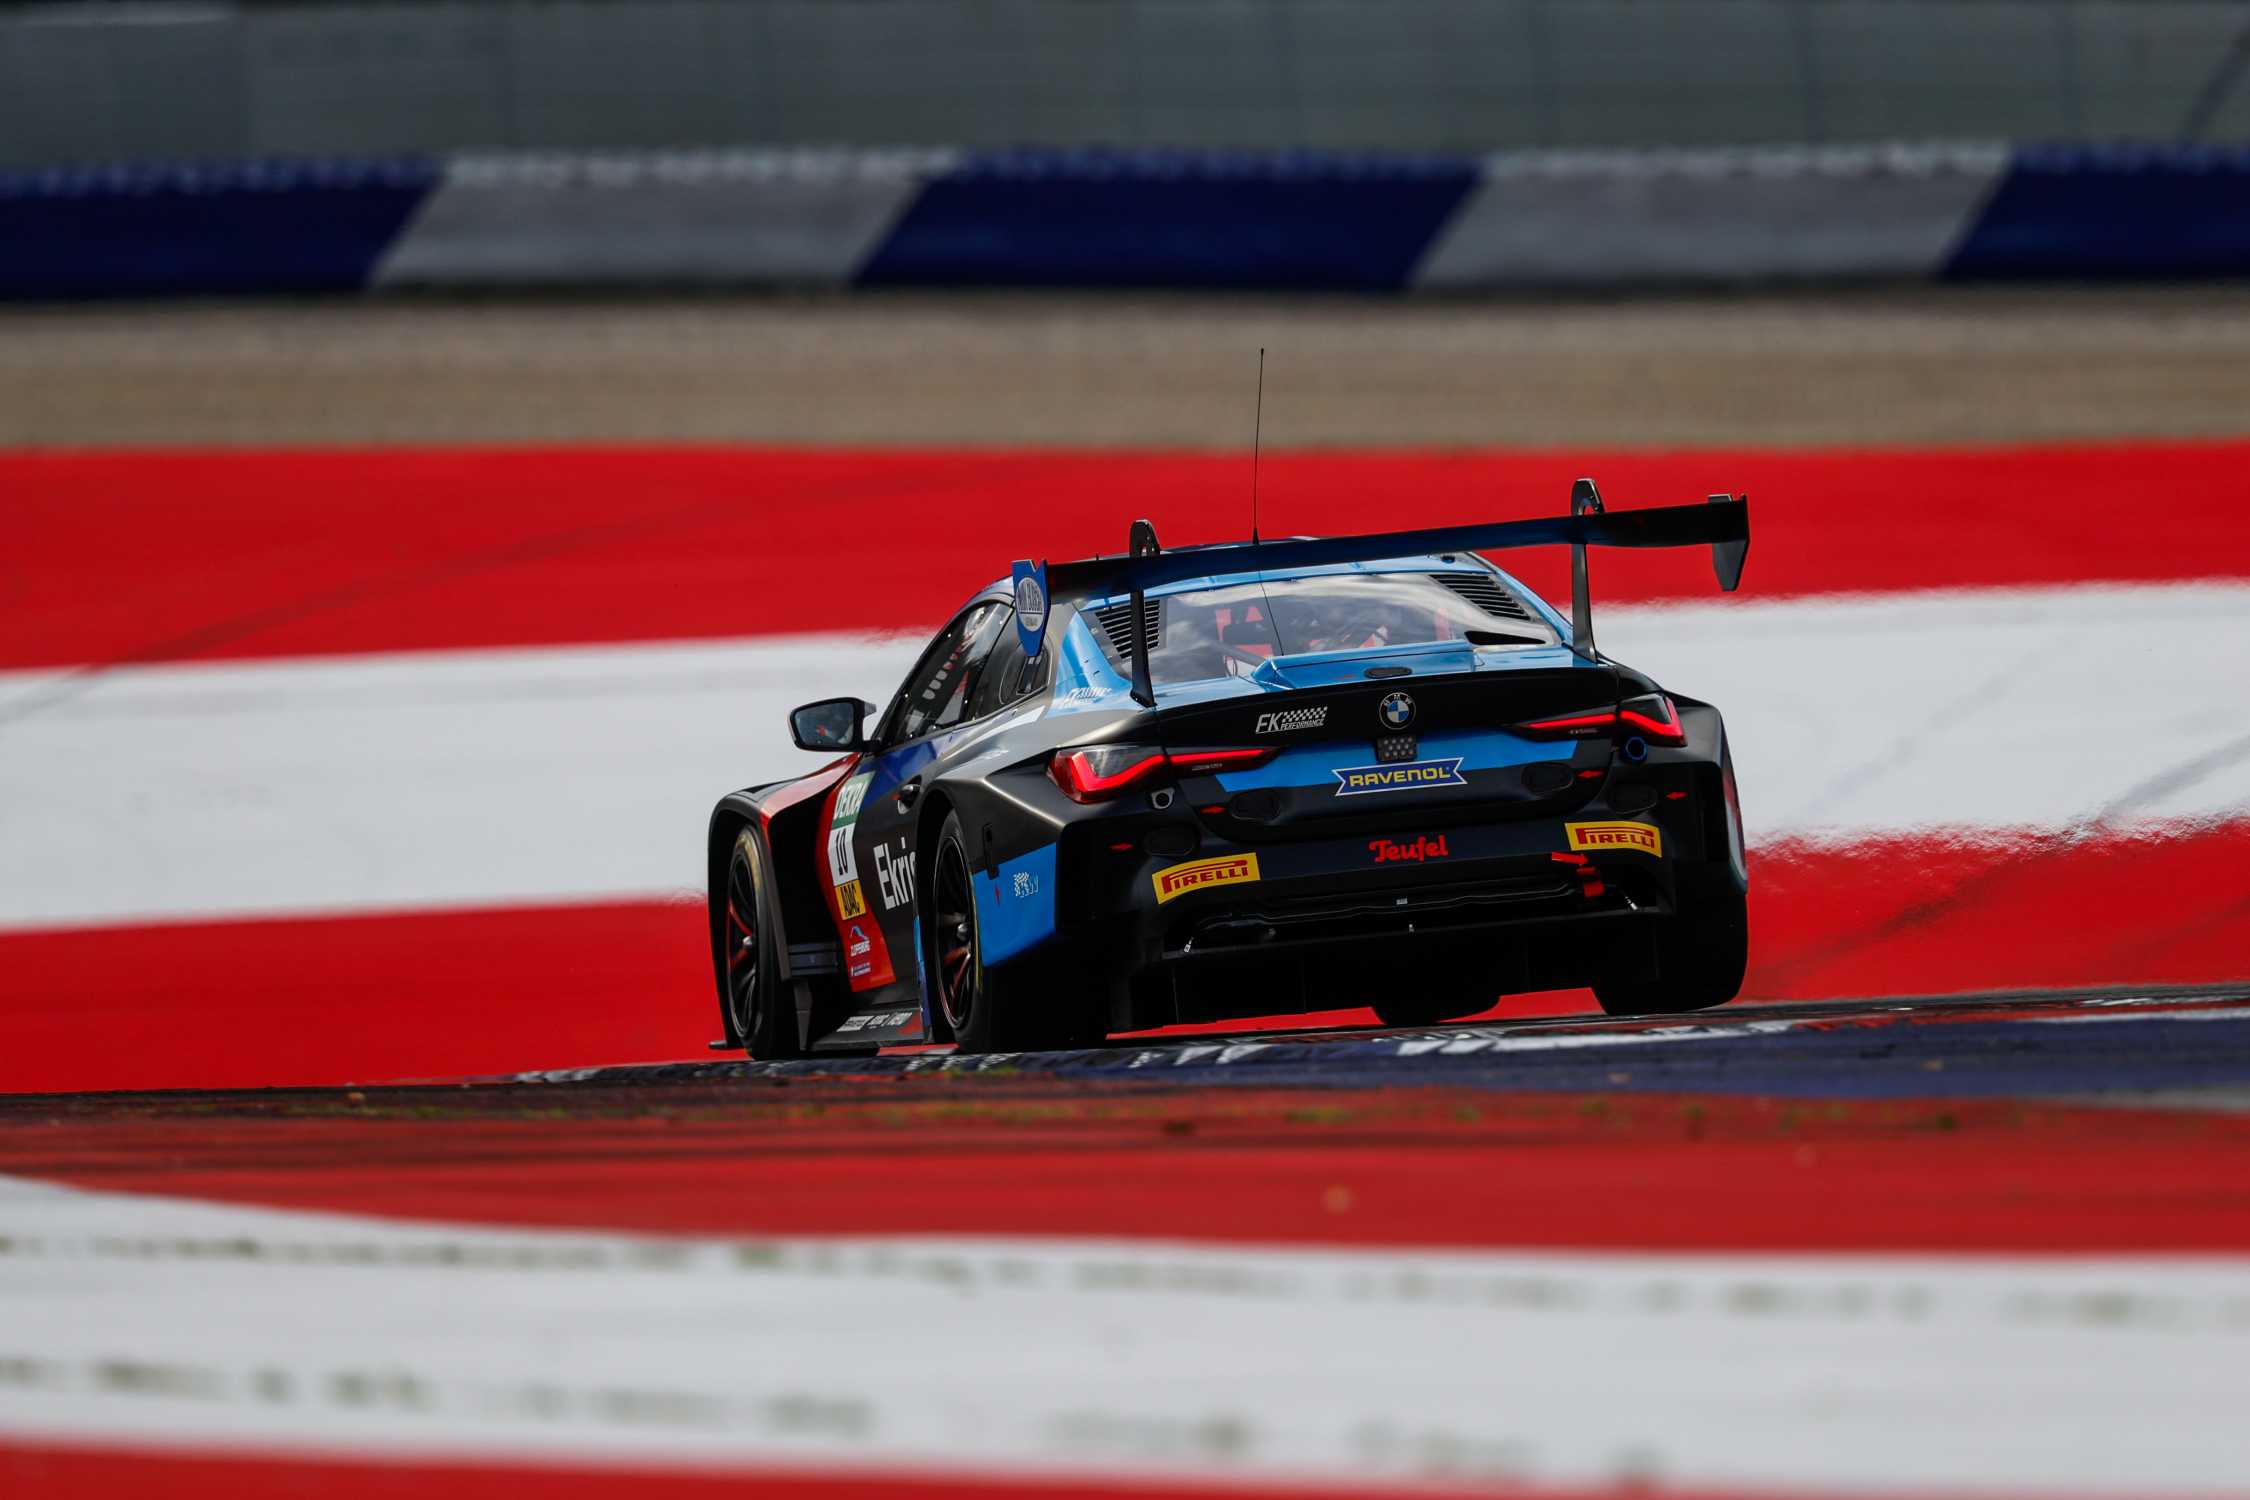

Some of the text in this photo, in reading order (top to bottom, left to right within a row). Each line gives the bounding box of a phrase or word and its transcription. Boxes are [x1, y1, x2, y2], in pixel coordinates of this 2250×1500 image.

[1256, 711, 1283, 733] FK
[1350, 767, 1451, 787] RAVENOL
[1369, 835, 1448, 862] Teufel
[1575, 826, 1655, 849] PIRELLI
[1161, 860, 1248, 894] PIRELLI
